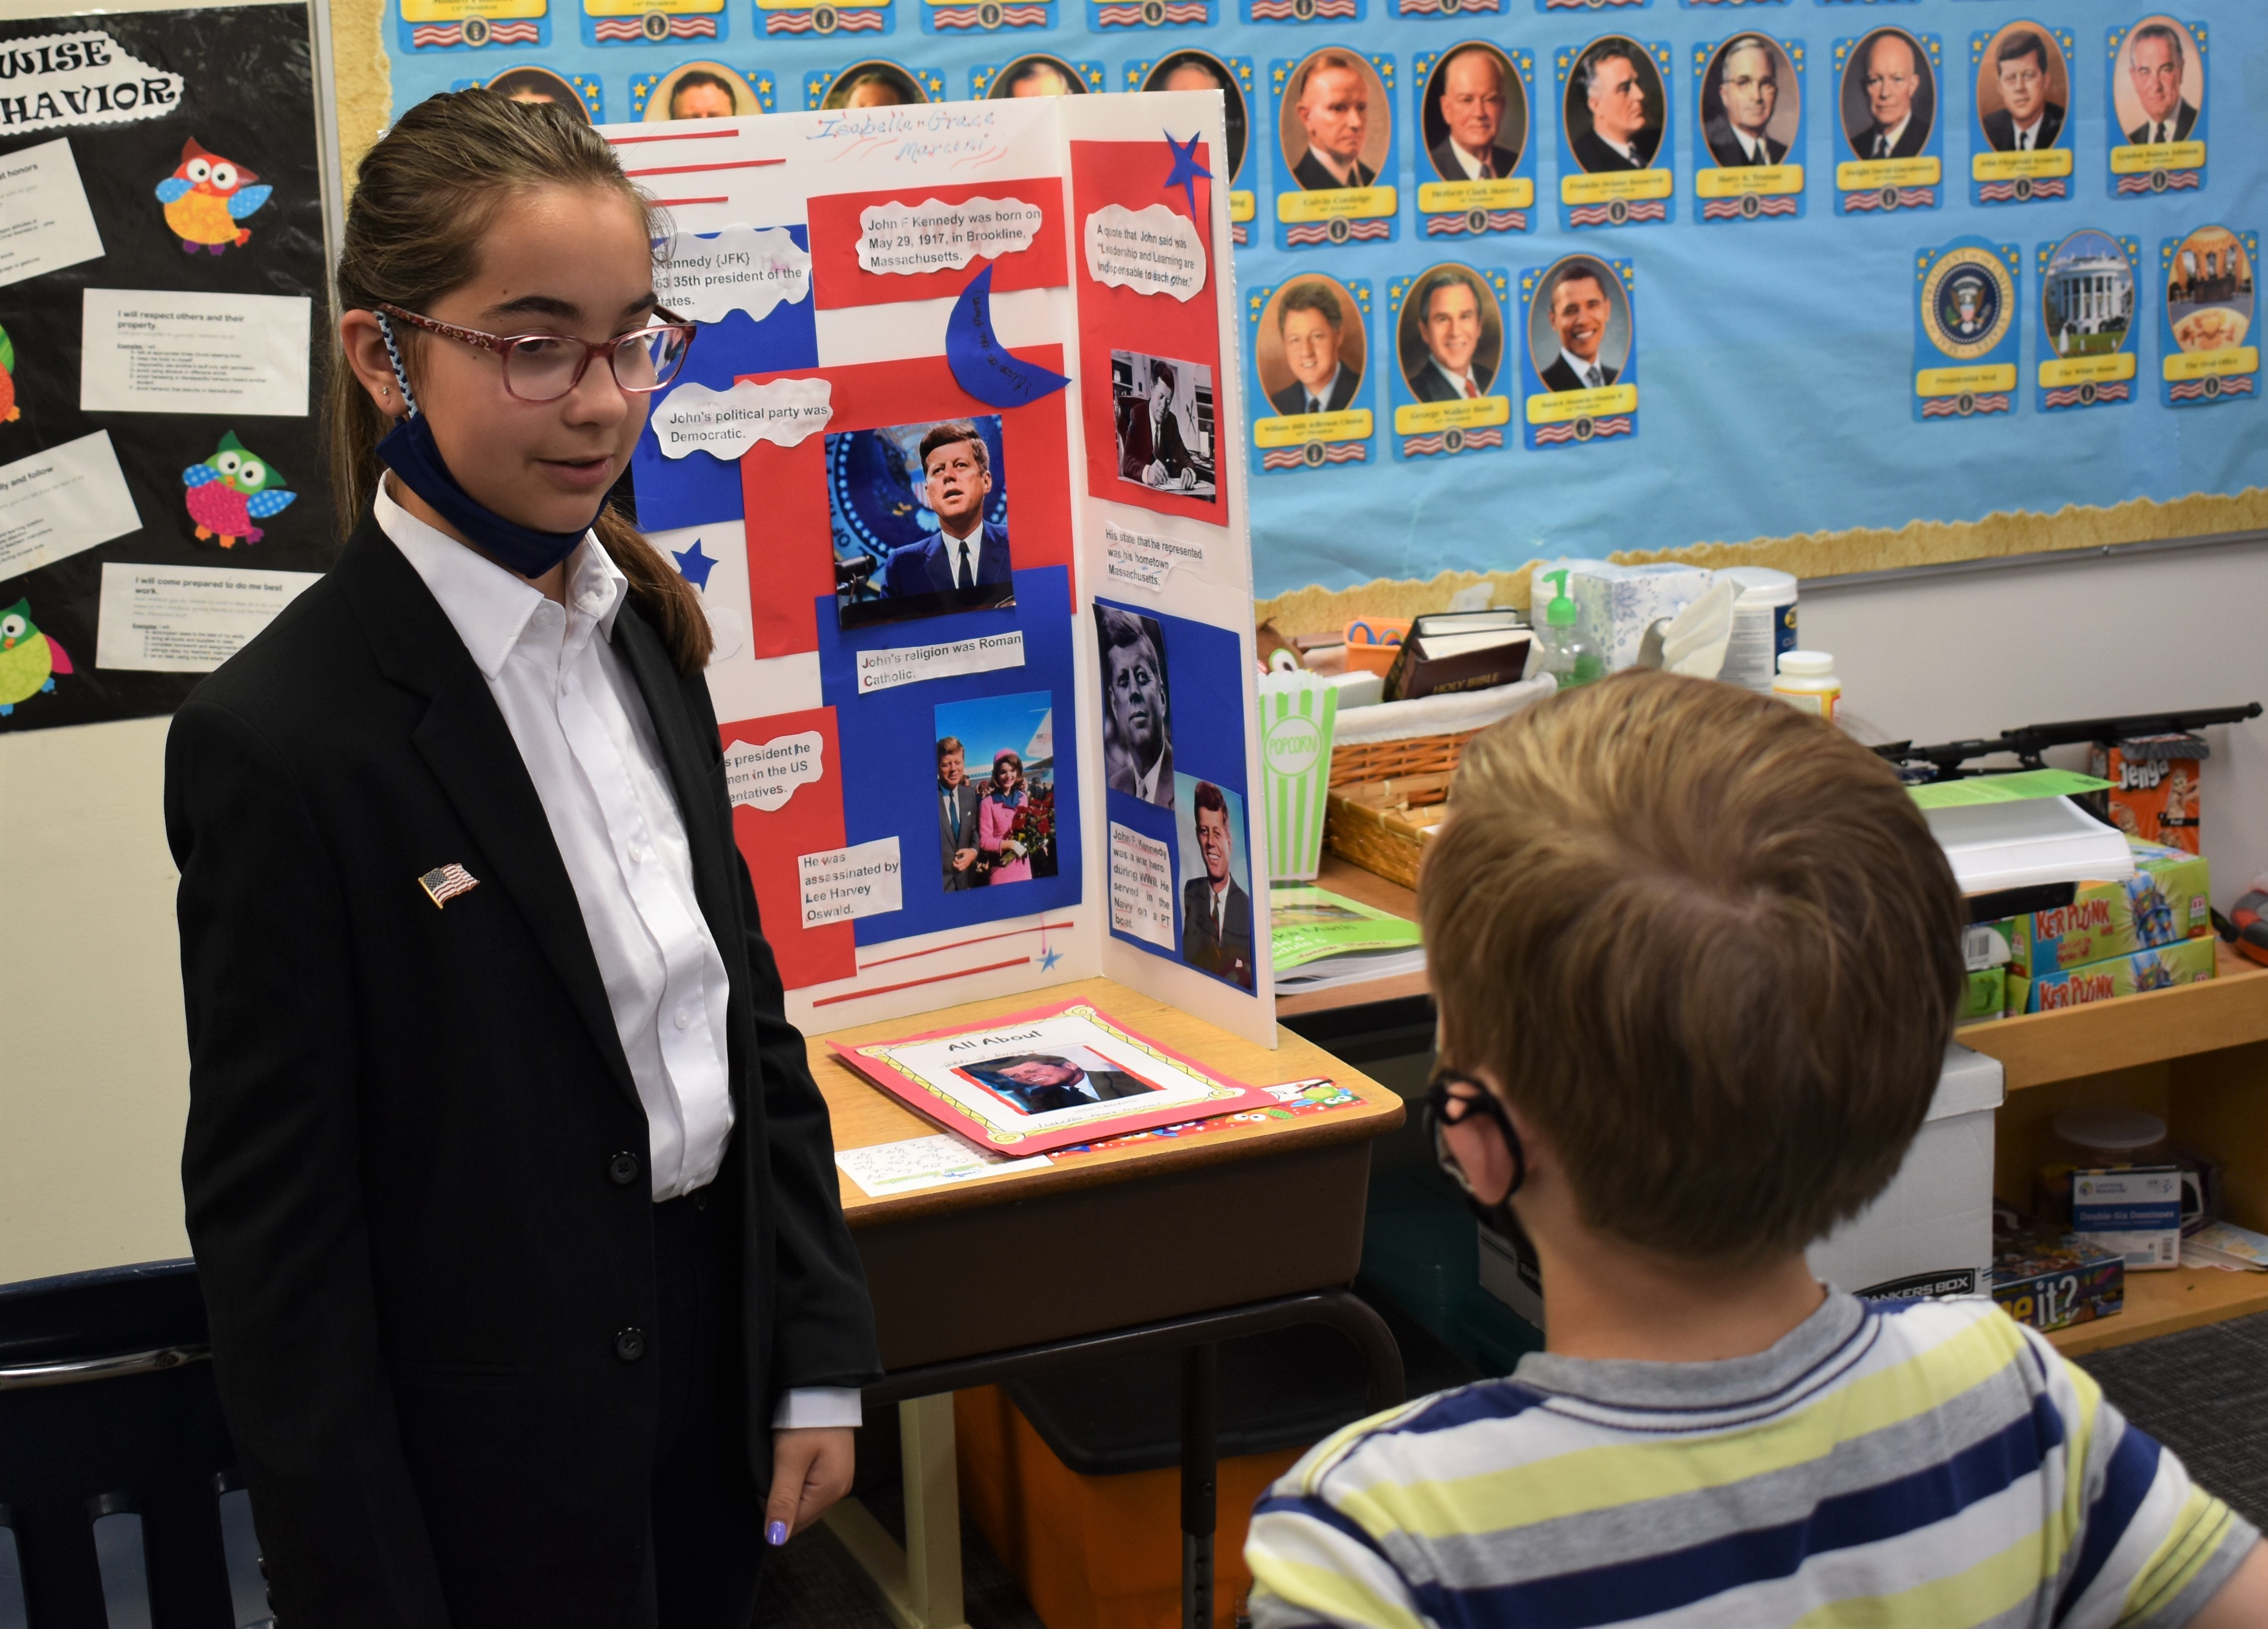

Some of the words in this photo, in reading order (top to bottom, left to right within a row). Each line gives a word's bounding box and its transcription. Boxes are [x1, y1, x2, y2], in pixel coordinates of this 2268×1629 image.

[0, 39, 112, 79] WISE
[868, 219, 897, 231] John
[913, 213, 965, 228] Kennedy
[968, 214, 992, 224] was
[996, 211, 1022, 222] born
[1025, 209, 1041, 219] on
[869, 237, 893, 250] May
[897, 236, 914, 247] 29,
[918, 233, 948, 246] 1917,
[952, 231, 963, 242] in
[967, 228, 1026, 242] Brookline,
[1097, 224, 1103, 235] A
[1104, 227, 1123, 238] quote
[1124, 228, 1138, 240] that
[1140, 231, 1157, 244] John
[1158, 234, 1173, 247] said
[1174, 238, 1187, 249] was
[715, 252, 751, 268] {JFK}
[870, 251, 963, 268] Massachusetts.
[1139, 250, 1152, 261] and
[1153, 252, 1183, 270] Learning
[1184, 260, 1195, 269] are
[674, 275, 701, 288] 35th
[704, 270, 764, 287] president
[767, 268, 780, 279] of
[783, 267, 803, 279] the
[1097, 260, 1144, 279] indispensable
[1145, 269, 1153, 280] to
[1153, 270, 1170, 284] each
[140, 312, 174, 321] respect
[176, 312, 203, 320] others
[225, 314, 245, 322] their
[669, 411, 711, 424] John's
[716, 408, 765, 423] political
[768, 406, 800, 421] party
[803, 406, 828, 416] was
[670, 428, 746, 443] Democratic.
[1105, 529, 1118, 540] His
[1119, 532, 1136, 544] state
[1137, 535, 1151, 548] that
[1151, 538, 1160, 550] he
[1162, 542, 1203, 559] represented
[1107, 549, 1121, 558] was
[1122, 550, 1133, 561] his
[1135, 552, 1170, 570] hometown
[183, 580, 223, 588] prepared
[1108, 564, 1160, 586] Massachusetts.
[862, 653, 902, 669] John's
[905, 646, 949, 662] religion
[952, 642, 976, 653] was
[979, 635, 1022, 649] Roman
[864, 669, 916, 687] Catholic.
[1432, 679, 1466, 694] HOLY
[1466, 672, 1500, 687] BIBLE
[734, 746, 793, 768] president
[1269, 736, 1317, 756] POPCORN
[752, 769, 764, 780] in
[767, 766, 787, 777] the
[790, 761, 808, 773] US
[2118, 760, 2170, 790] Jenga
[1113, 829, 1130, 843] John
[1131, 836, 1138, 846] F.
[1138, 839, 1167, 860] Kennedy
[804, 856, 819, 868] He
[821, 854, 846, 866] was
[1113, 847, 1128, 860] was
[1129, 853, 1135, 862] a
[1136, 856, 1148, 866] war
[1149, 859, 1164, 873] hero
[805, 863, 881, 886] assassinated
[884, 861, 899, 873] by
[1114, 864, 1138, 882] during
[1160, 879, 1170, 892] He
[805, 892, 827, 904] Lee
[830, 885, 871, 899] Harvey
[1114, 882, 1139, 897] served
[1146, 891, 1153, 902] in
[1159, 897, 1170, 910] the
[806, 904, 854, 921] Oswald.
[1114, 897, 1133, 913] Navy
[1138, 907, 1147, 917] on
[1153, 912, 1157, 921] a
[1161, 914, 1170, 926] PT
[1115, 913, 1133, 929] boat.
[1301, 925, 1357, 933] Math
[948, 1040, 977, 1052] All
[982, 1030, 1043, 1045] About
[1935, 1277, 1969, 1293] BOX
[2035, 1275, 2079, 1326] it?
